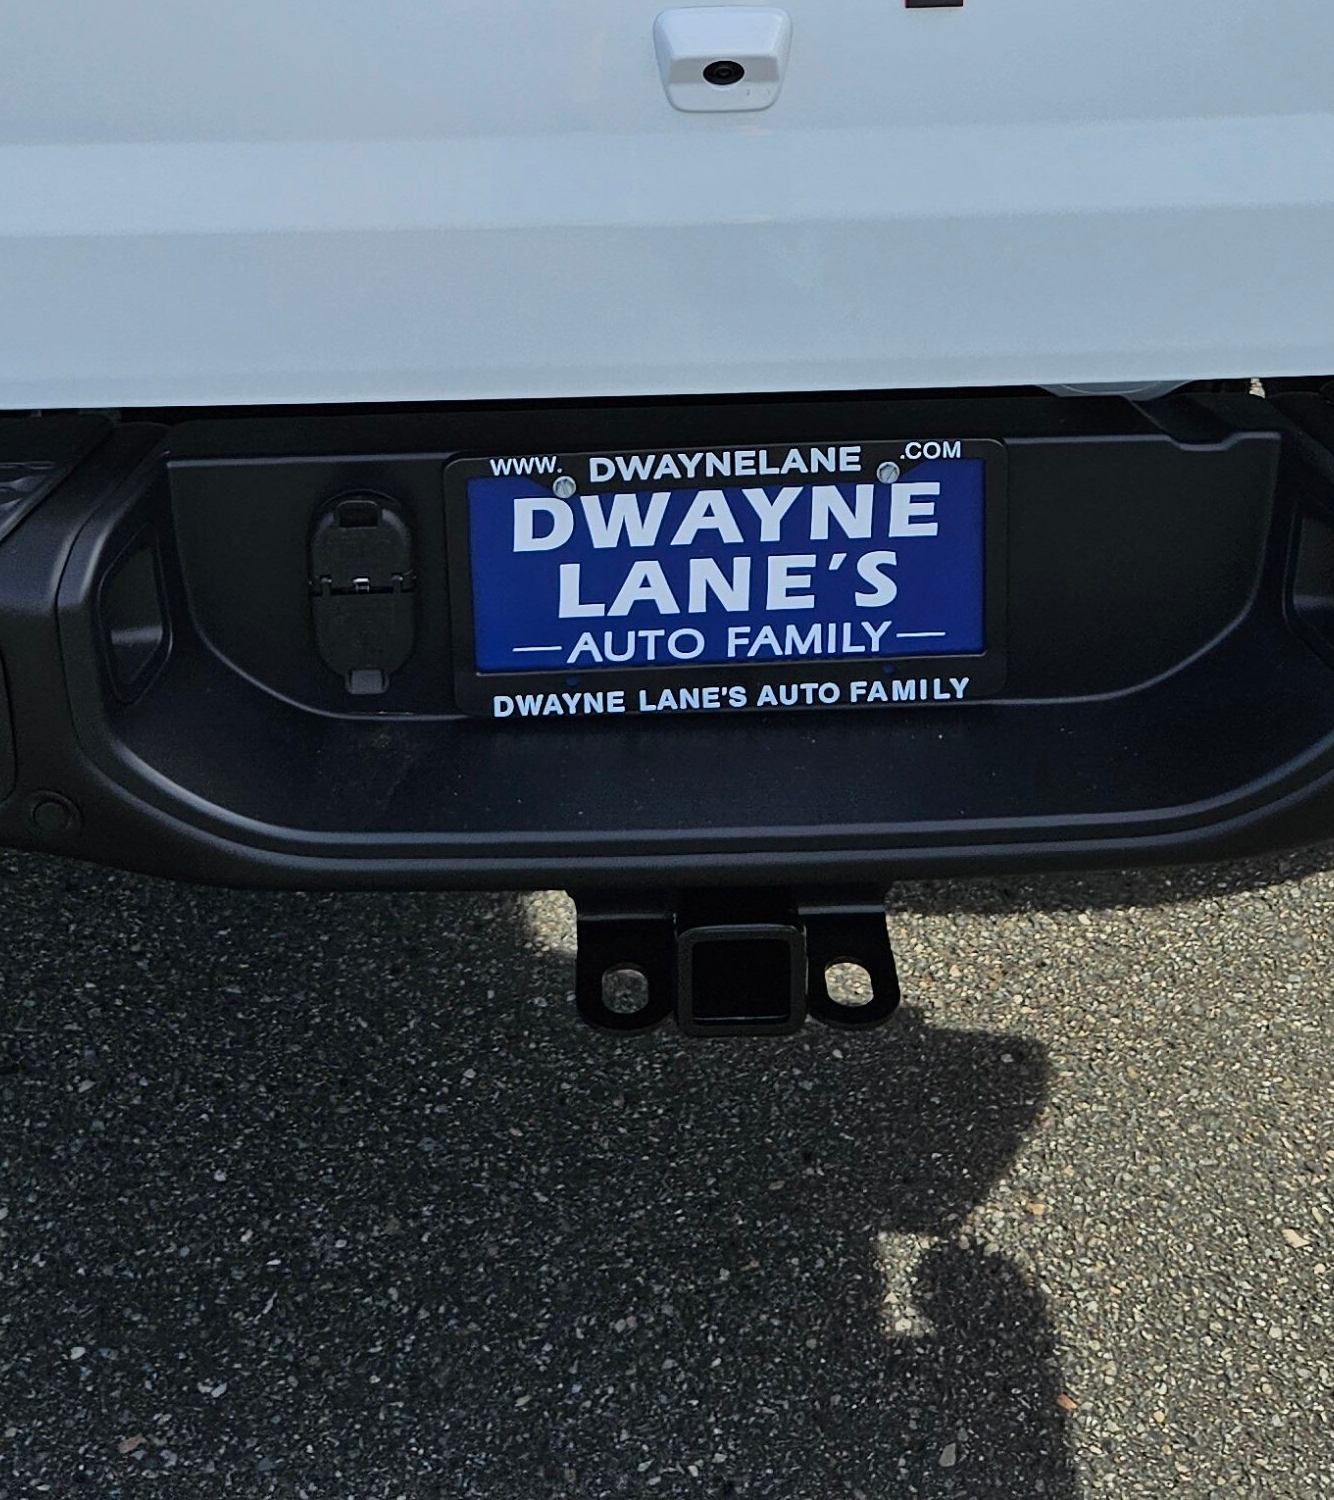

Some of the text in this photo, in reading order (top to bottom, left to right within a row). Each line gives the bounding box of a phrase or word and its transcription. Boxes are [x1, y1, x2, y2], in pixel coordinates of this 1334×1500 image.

[490, 441, 961, 482] WWW. DWAYNELANE .COM
[513, 482, 940, 552] DWAYNE
[558, 551, 898, 618] LANE'S
[567, 620, 892, 663] AUTO FAMILY
[493, 677, 970, 717] DWAYNE LANE'S AUTO FAMILY
